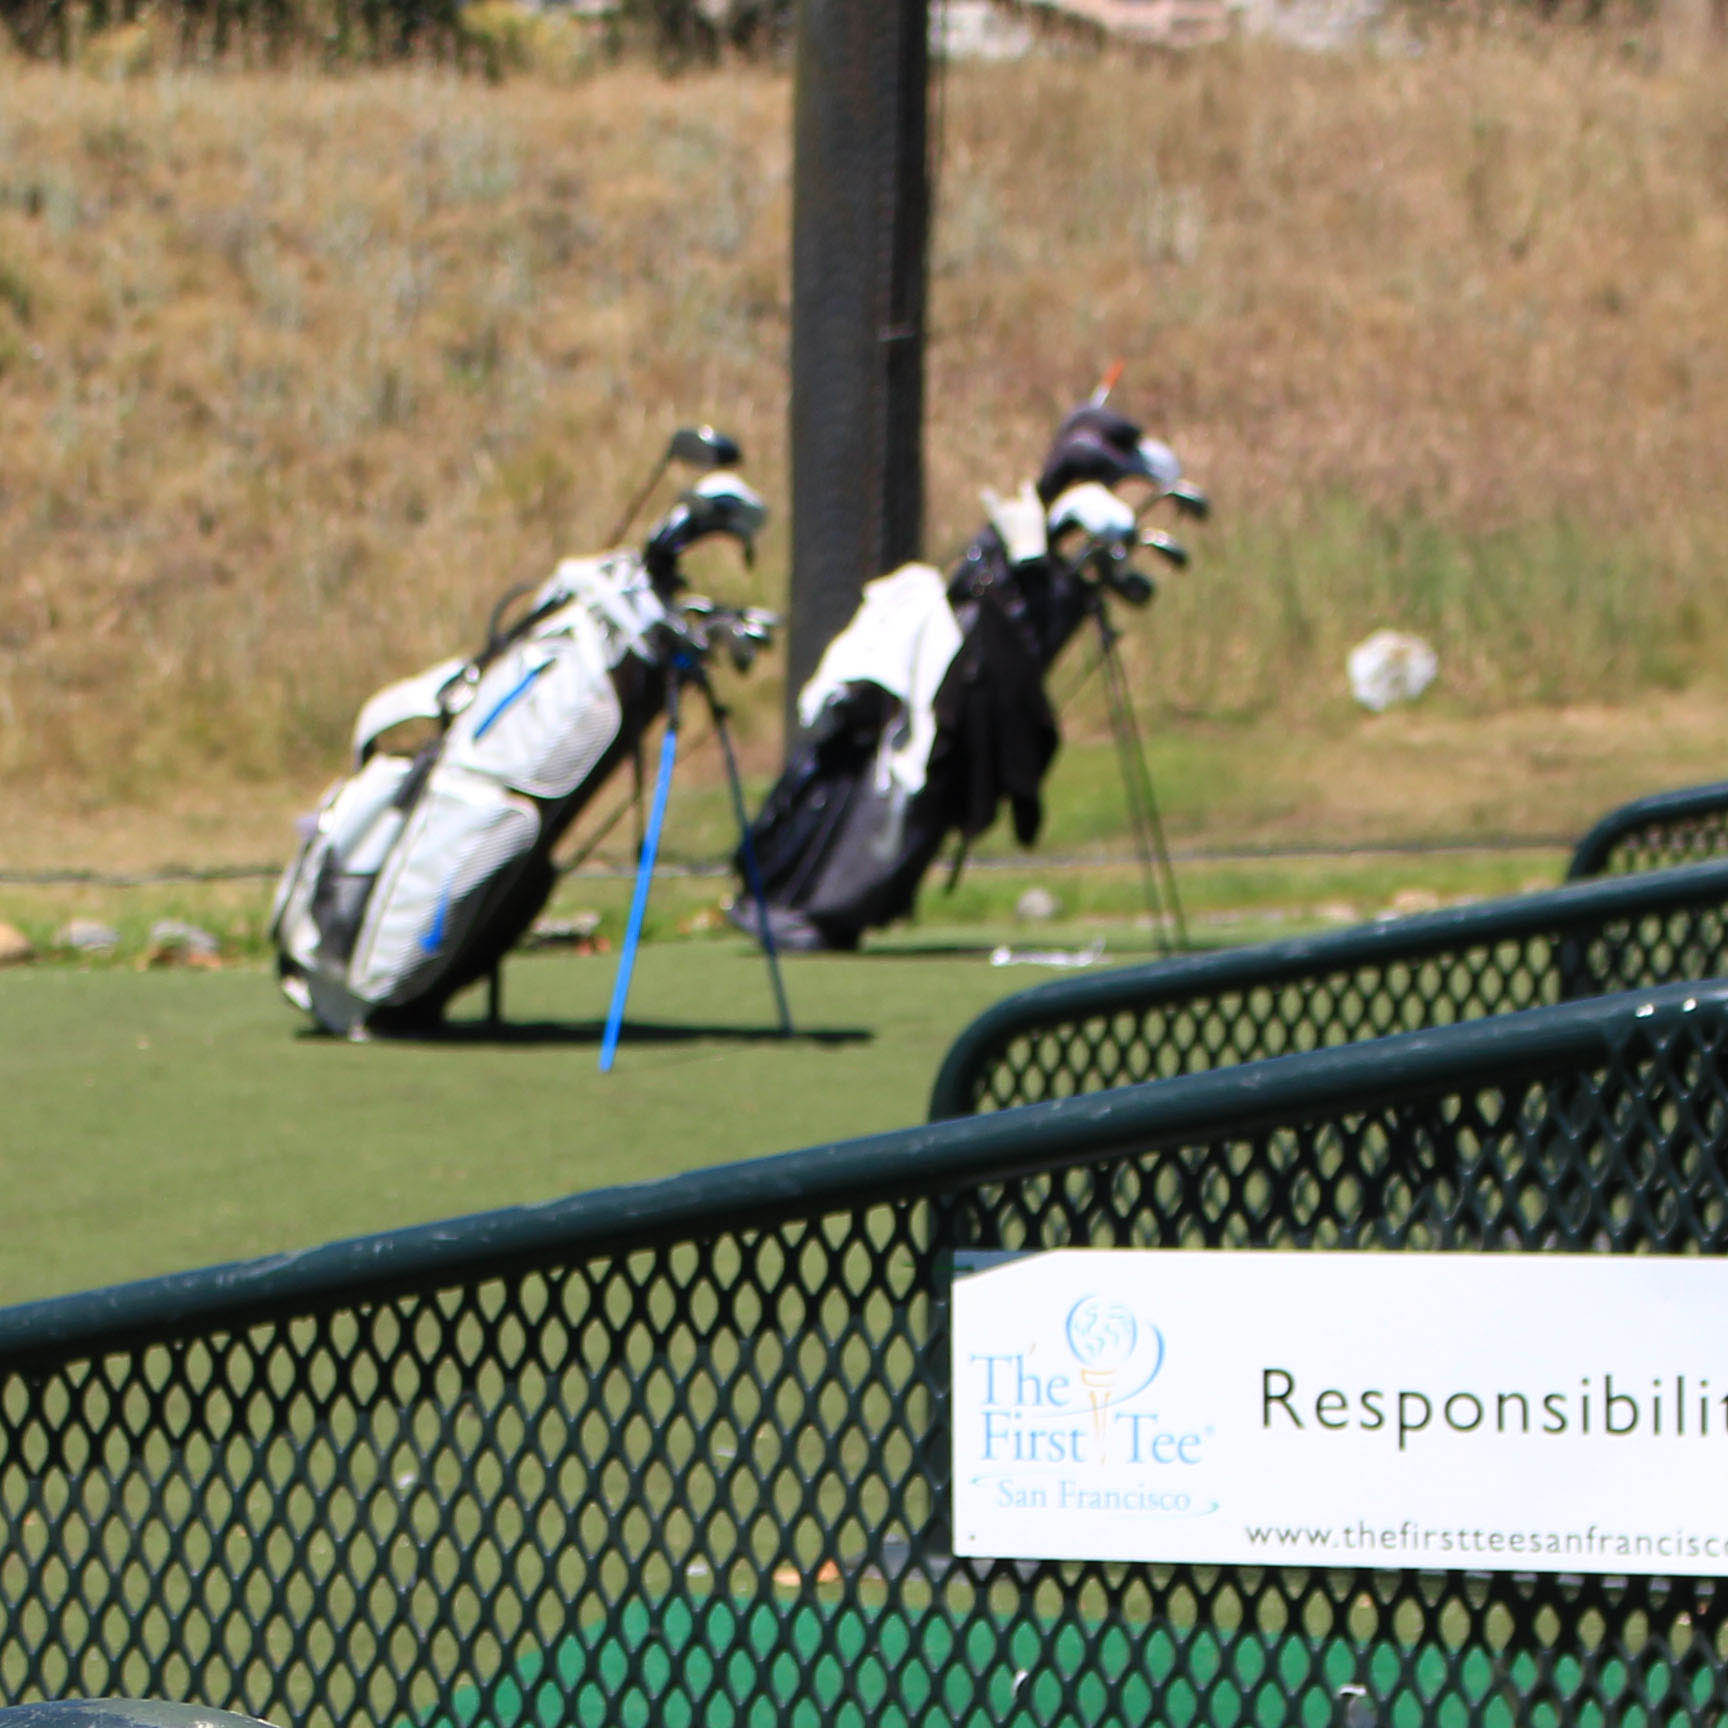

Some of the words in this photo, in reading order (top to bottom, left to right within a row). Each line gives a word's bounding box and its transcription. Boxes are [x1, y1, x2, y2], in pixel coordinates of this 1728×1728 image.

[970, 1353, 1071, 1408] The
[980, 1409, 1086, 1463] First
[996, 1477, 1048, 1509] San
[1057, 1479, 1192, 1512] Francisco
